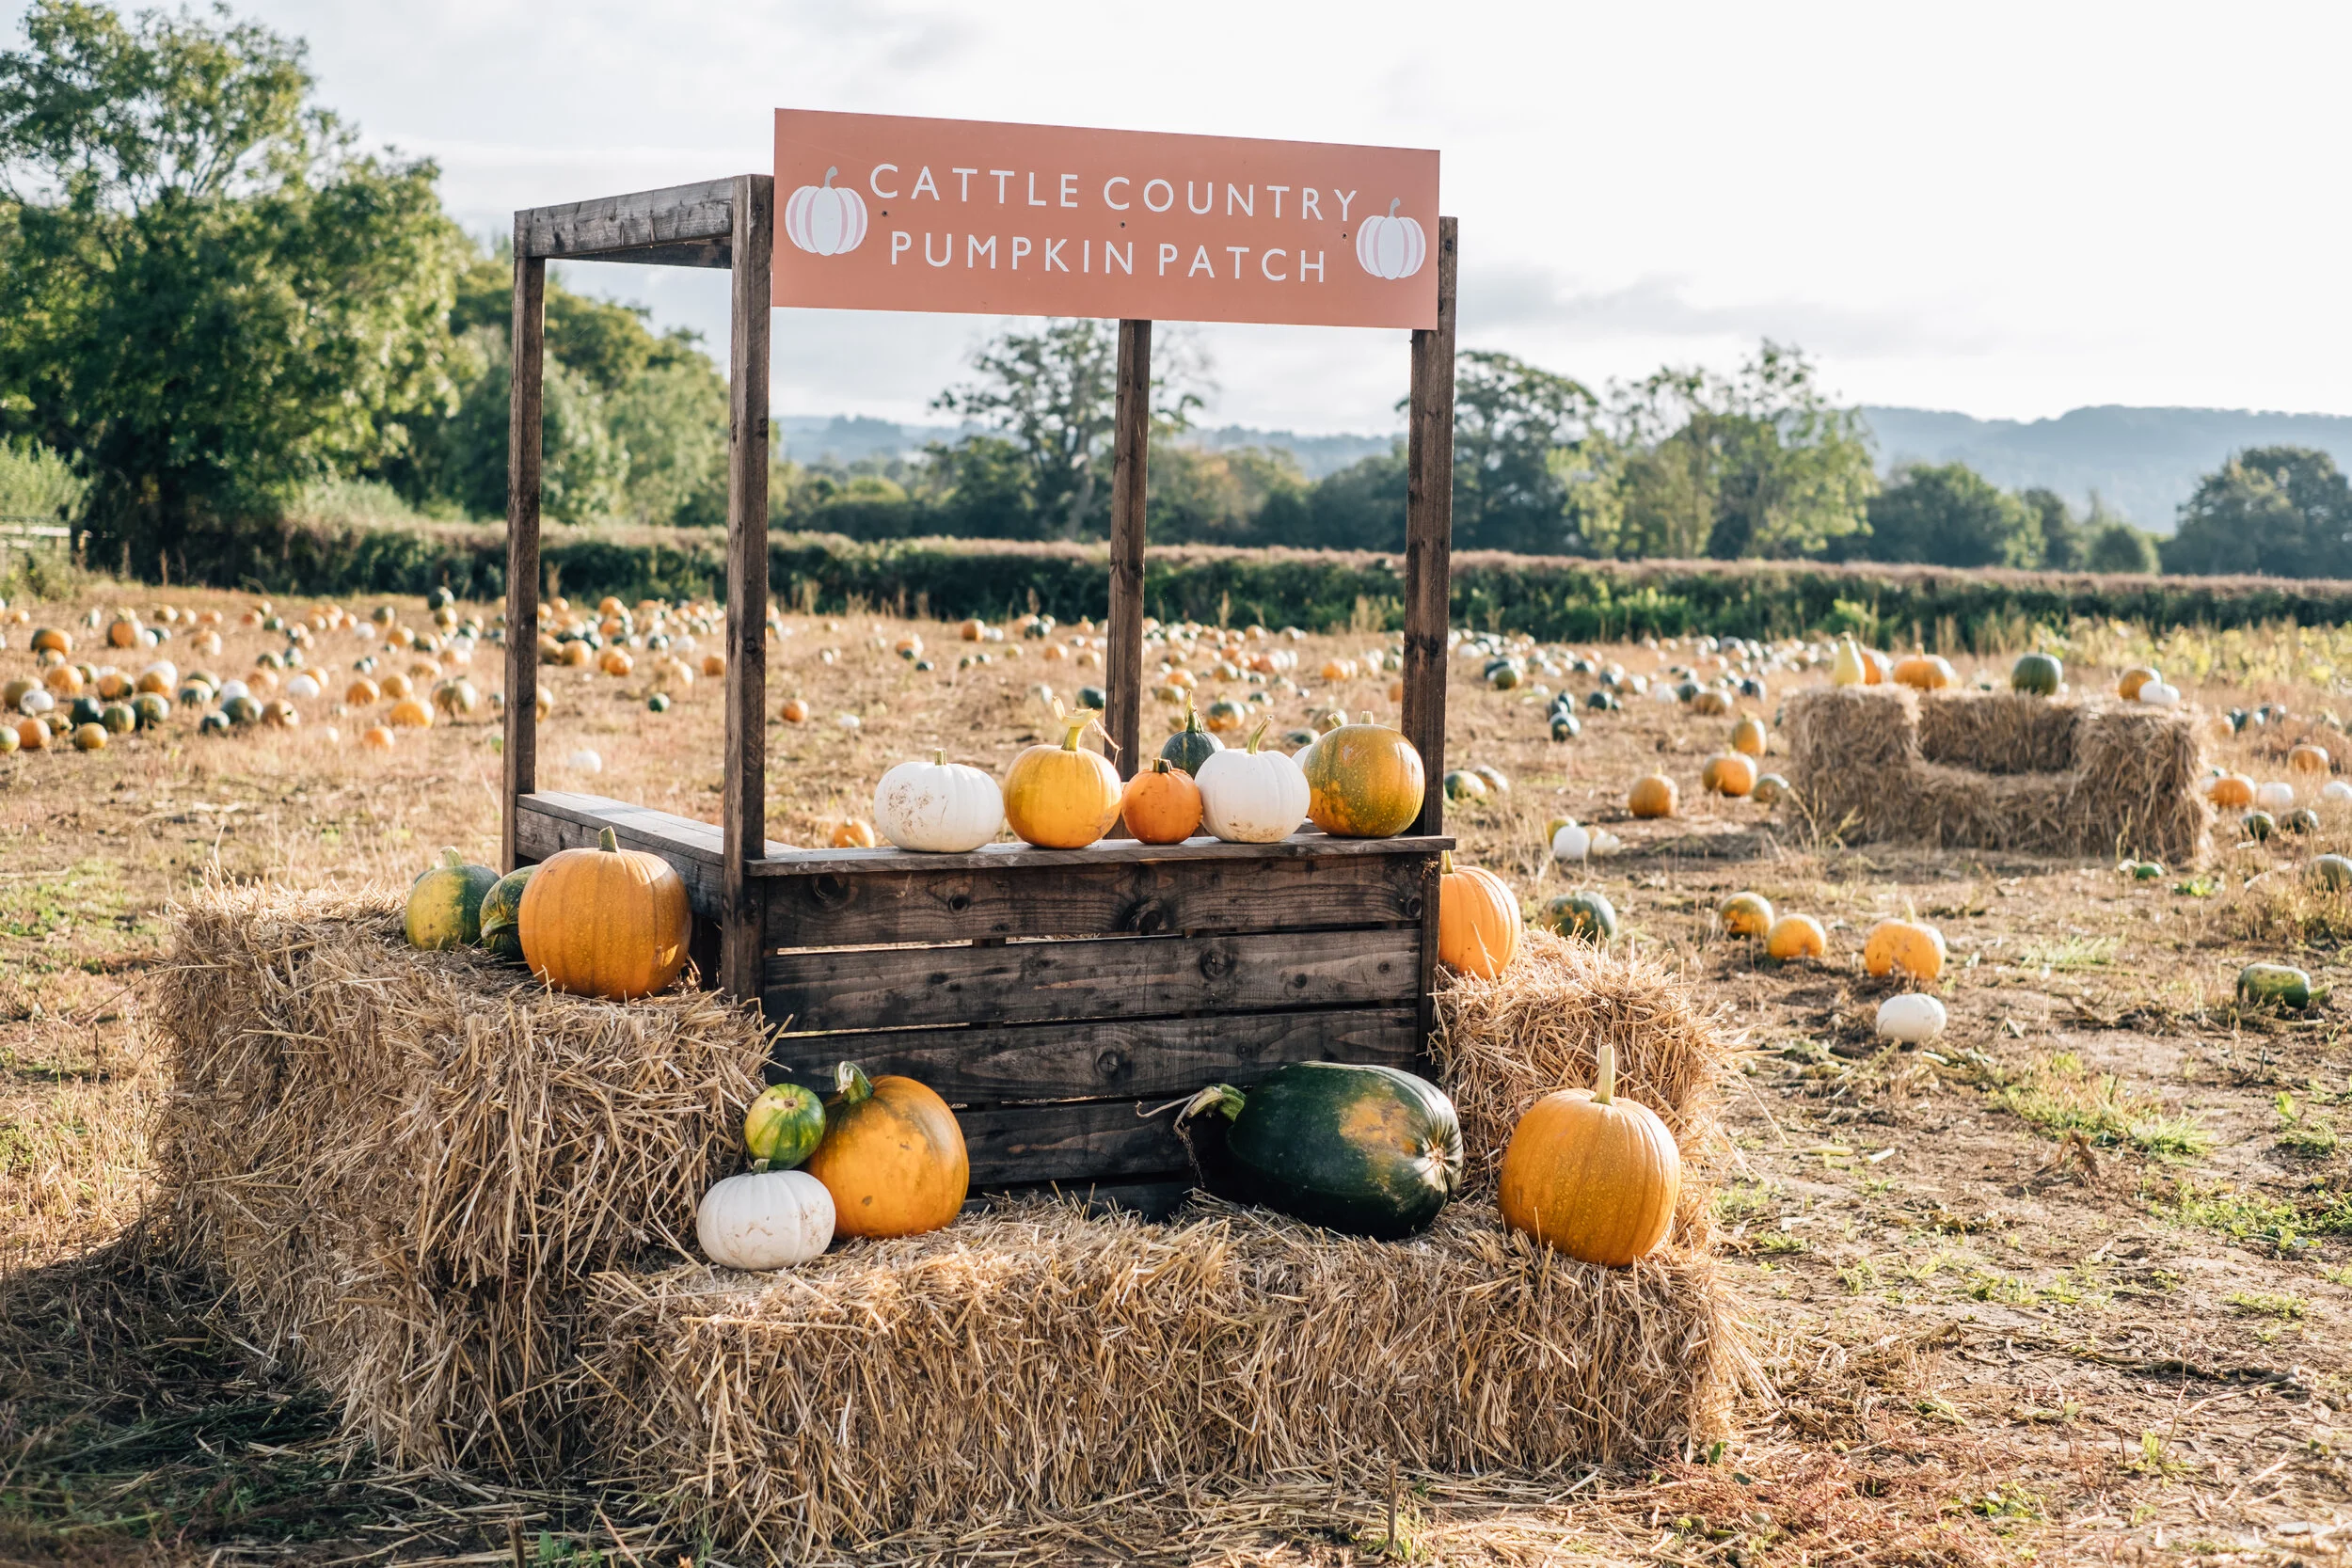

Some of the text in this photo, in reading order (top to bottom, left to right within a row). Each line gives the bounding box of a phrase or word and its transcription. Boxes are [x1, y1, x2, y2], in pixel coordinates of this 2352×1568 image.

[869, 163, 1358, 222] CATTLE COUNTRY
[890, 230, 1325, 283] PUMPKIN PATCH
